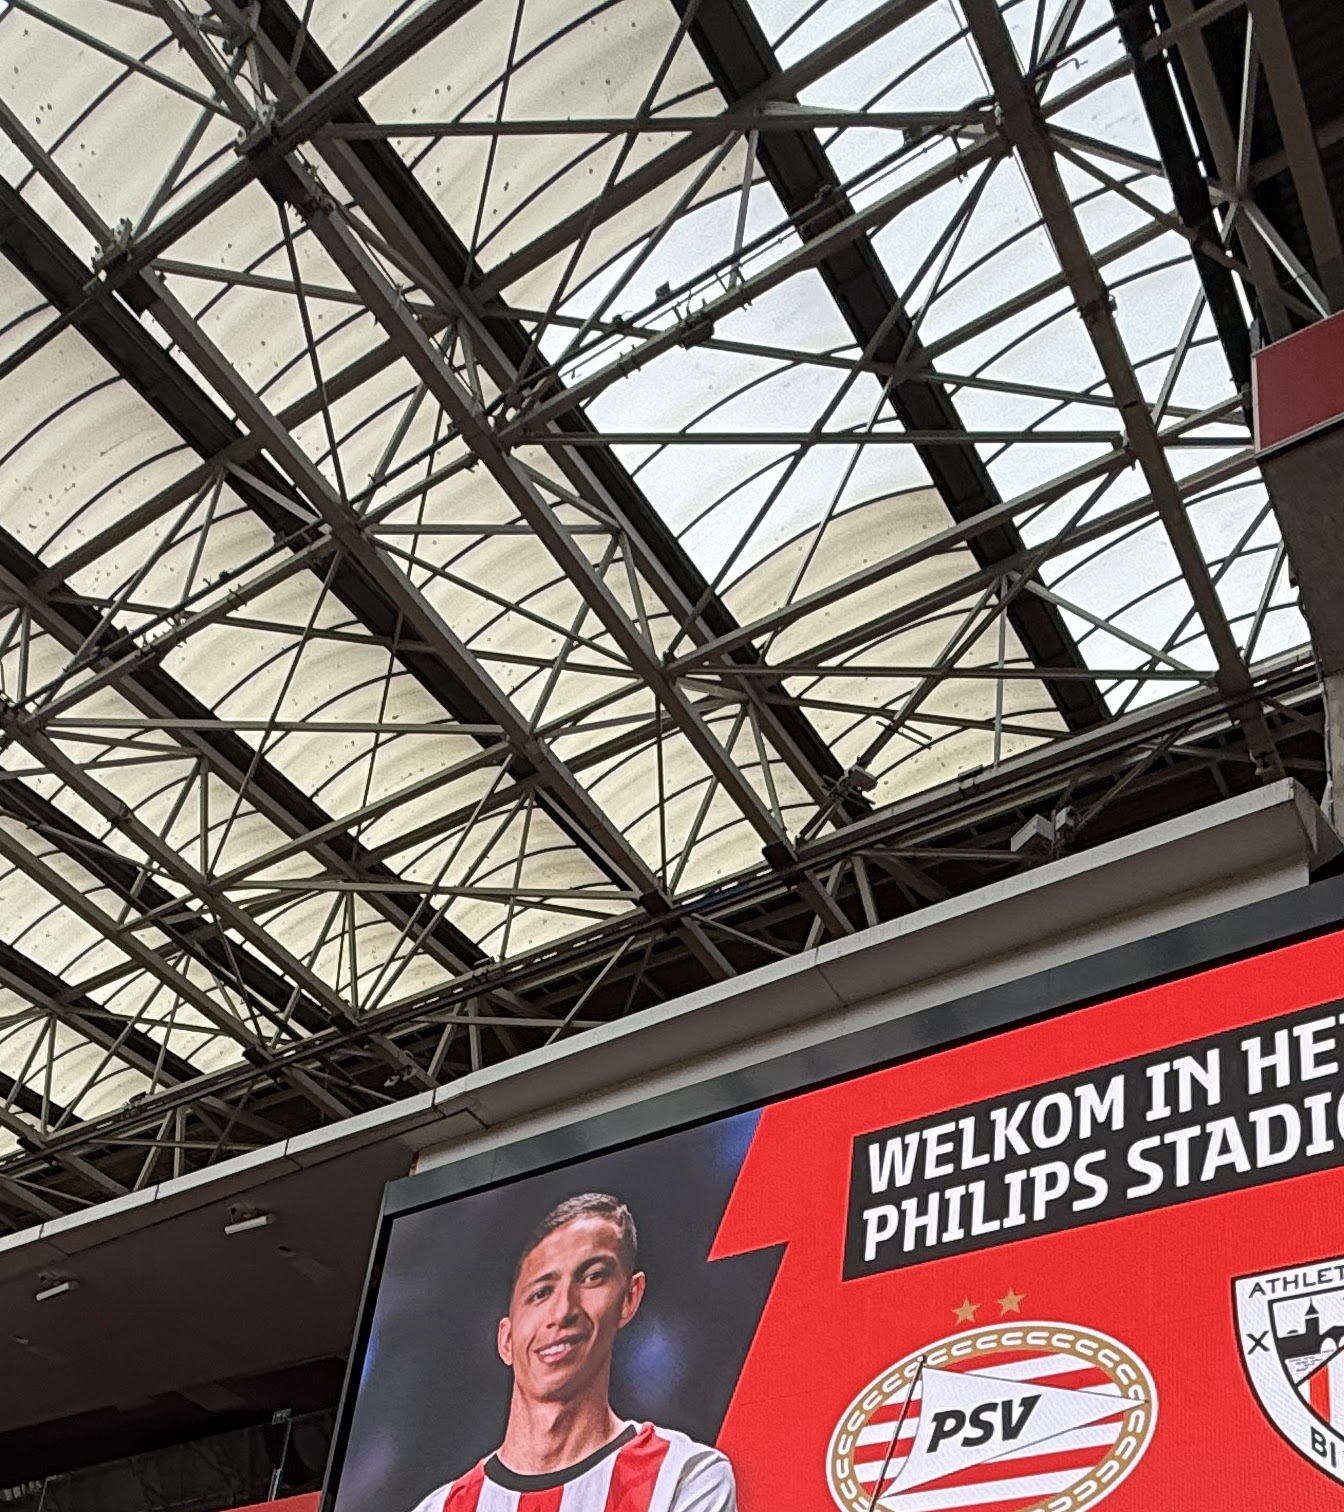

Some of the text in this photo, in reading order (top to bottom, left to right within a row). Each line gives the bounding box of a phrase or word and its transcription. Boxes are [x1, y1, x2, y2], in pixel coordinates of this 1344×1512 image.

[868, 1074, 1125, 1194] WELKOM
[1145, 1047, 1221, 1121] IN
[863, 1149, 1109, 1262] PHILIPS
[925, 1393, 1043, 1454] PSV
